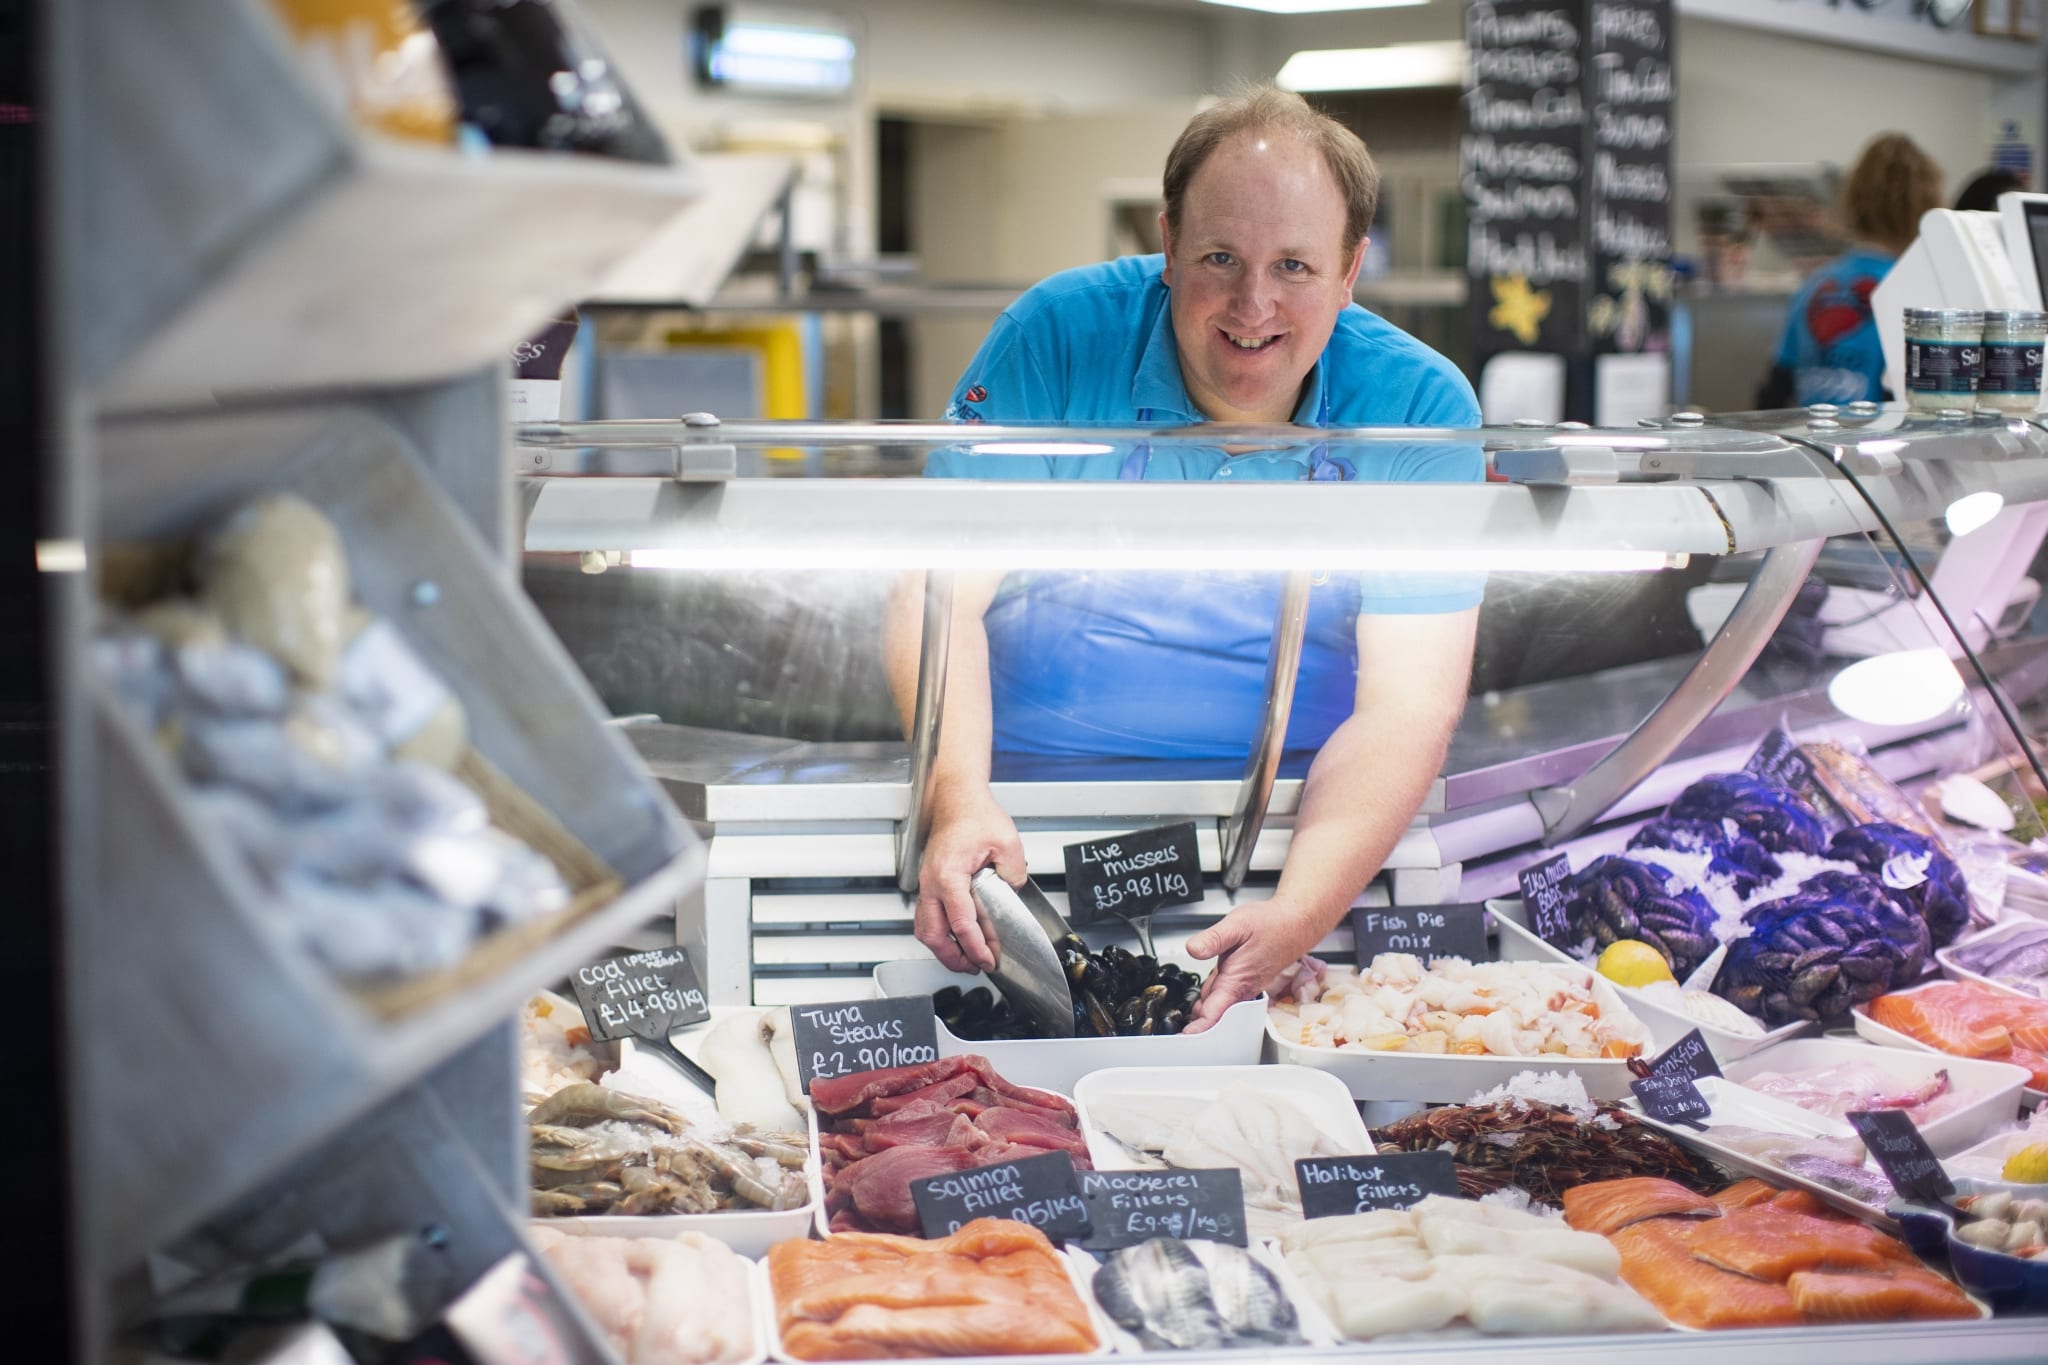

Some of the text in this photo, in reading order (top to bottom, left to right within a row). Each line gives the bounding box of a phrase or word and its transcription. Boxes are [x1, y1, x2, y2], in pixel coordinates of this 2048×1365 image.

[1081, 843, 1122, 863] Live
[1103, 845, 1179, 877] mussels
[1366, 911, 1445, 933] Fish Pie
[1388, 933, 1431, 949] mix
[579, 960, 625, 985] Cod
[800, 1006, 864, 1028] Tuna
[1664, 1076, 1690, 1092] Dory
[927, 1164, 1020, 1200] Salmon
[1084, 1175, 1198, 1194] Mackerel
[1302, 1163, 1384, 1185] Halibut
[1111, 1193, 1190, 1209] Fillets
[1356, 1183, 1422, 1200] Fillets
